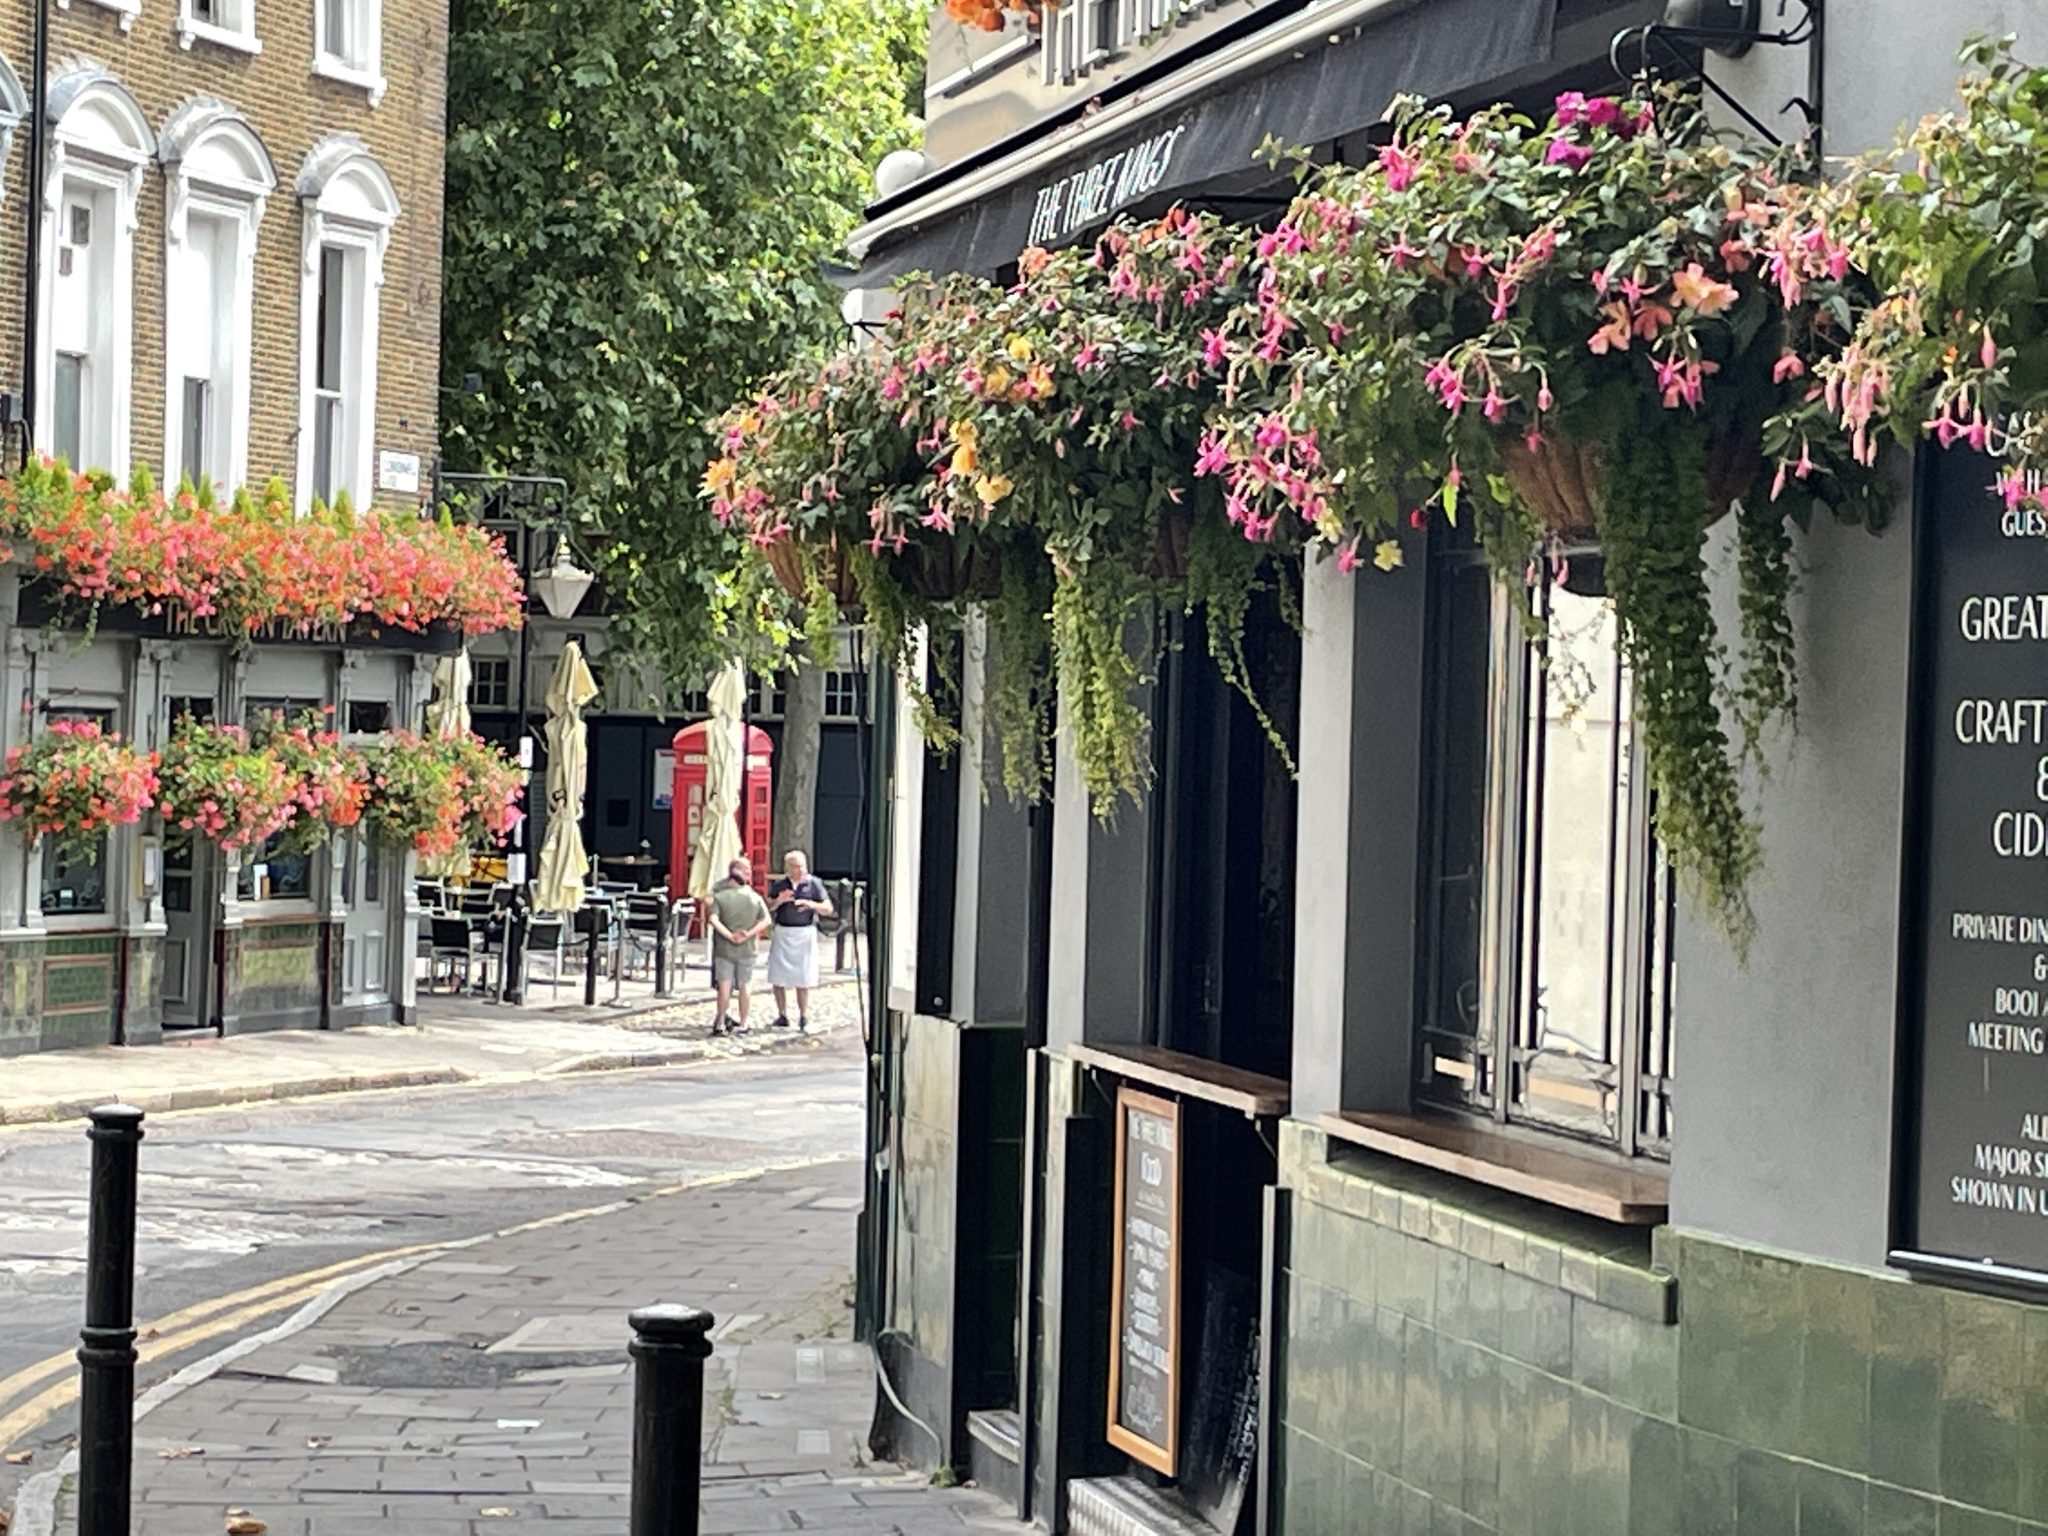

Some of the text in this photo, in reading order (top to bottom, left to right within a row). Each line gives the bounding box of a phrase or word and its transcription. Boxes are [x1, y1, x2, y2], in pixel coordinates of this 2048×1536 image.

[1028, 178, 1069, 243] THE
[1961, 595, 2048, 641] GREAT
[1955, 699, 2048, 744] CRAFT
[1993, 811, 2048, 857] CID
[1952, 912, 2016, 942] PRIVATE
[1968, 1021, 2045, 1054] MEETING
[1975, 1143, 2032, 1178] MAJOR
[1951, 1176, 2015, 1210] SHOWN
[2017, 1185, 2037, 1213] IN
